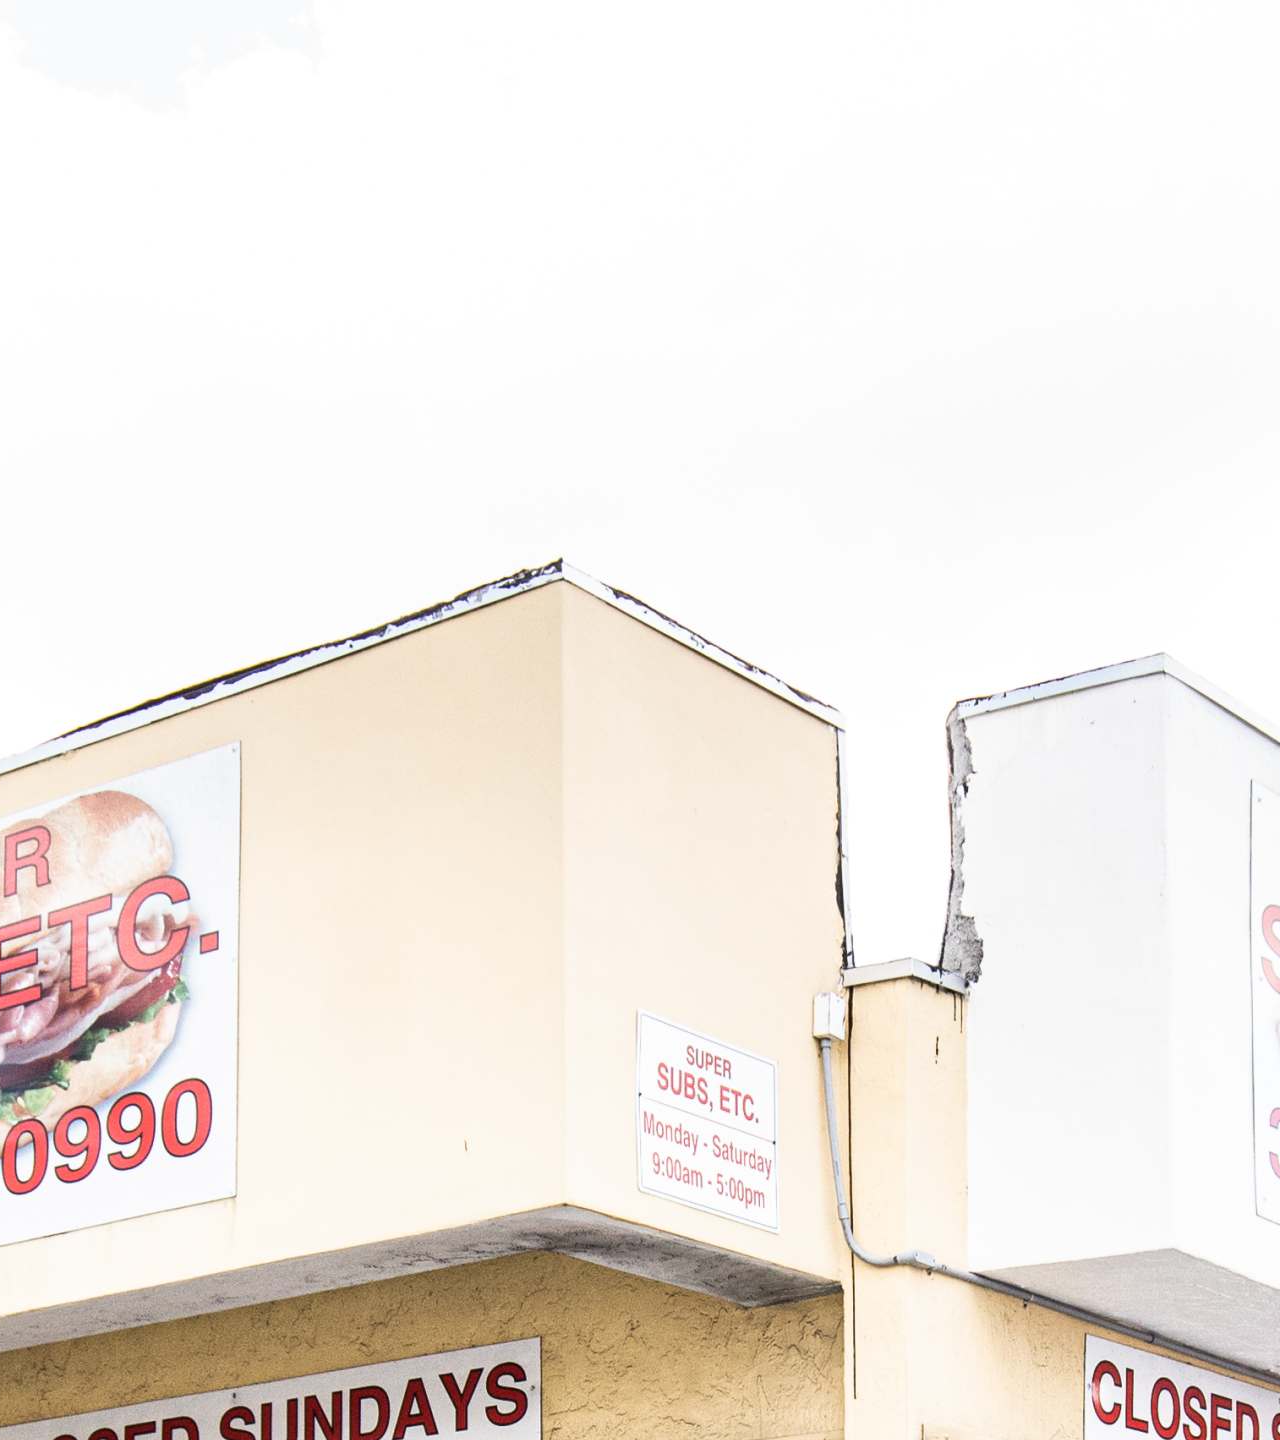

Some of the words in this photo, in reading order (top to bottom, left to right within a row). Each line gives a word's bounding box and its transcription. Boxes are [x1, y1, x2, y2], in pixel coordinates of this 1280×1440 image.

[686, 1045, 732, 1079] SUPER
[657, 1062, 714, 1112] SUBS,
[720, 1085, 759, 1123] ETC.
[643, 1111, 699, 1156] Monday
[712, 1135, 772, 1180] Saturday
[652, 1152, 703, 1188] 9:00am
[716, 1173, 765, 1208] 5:00pm
